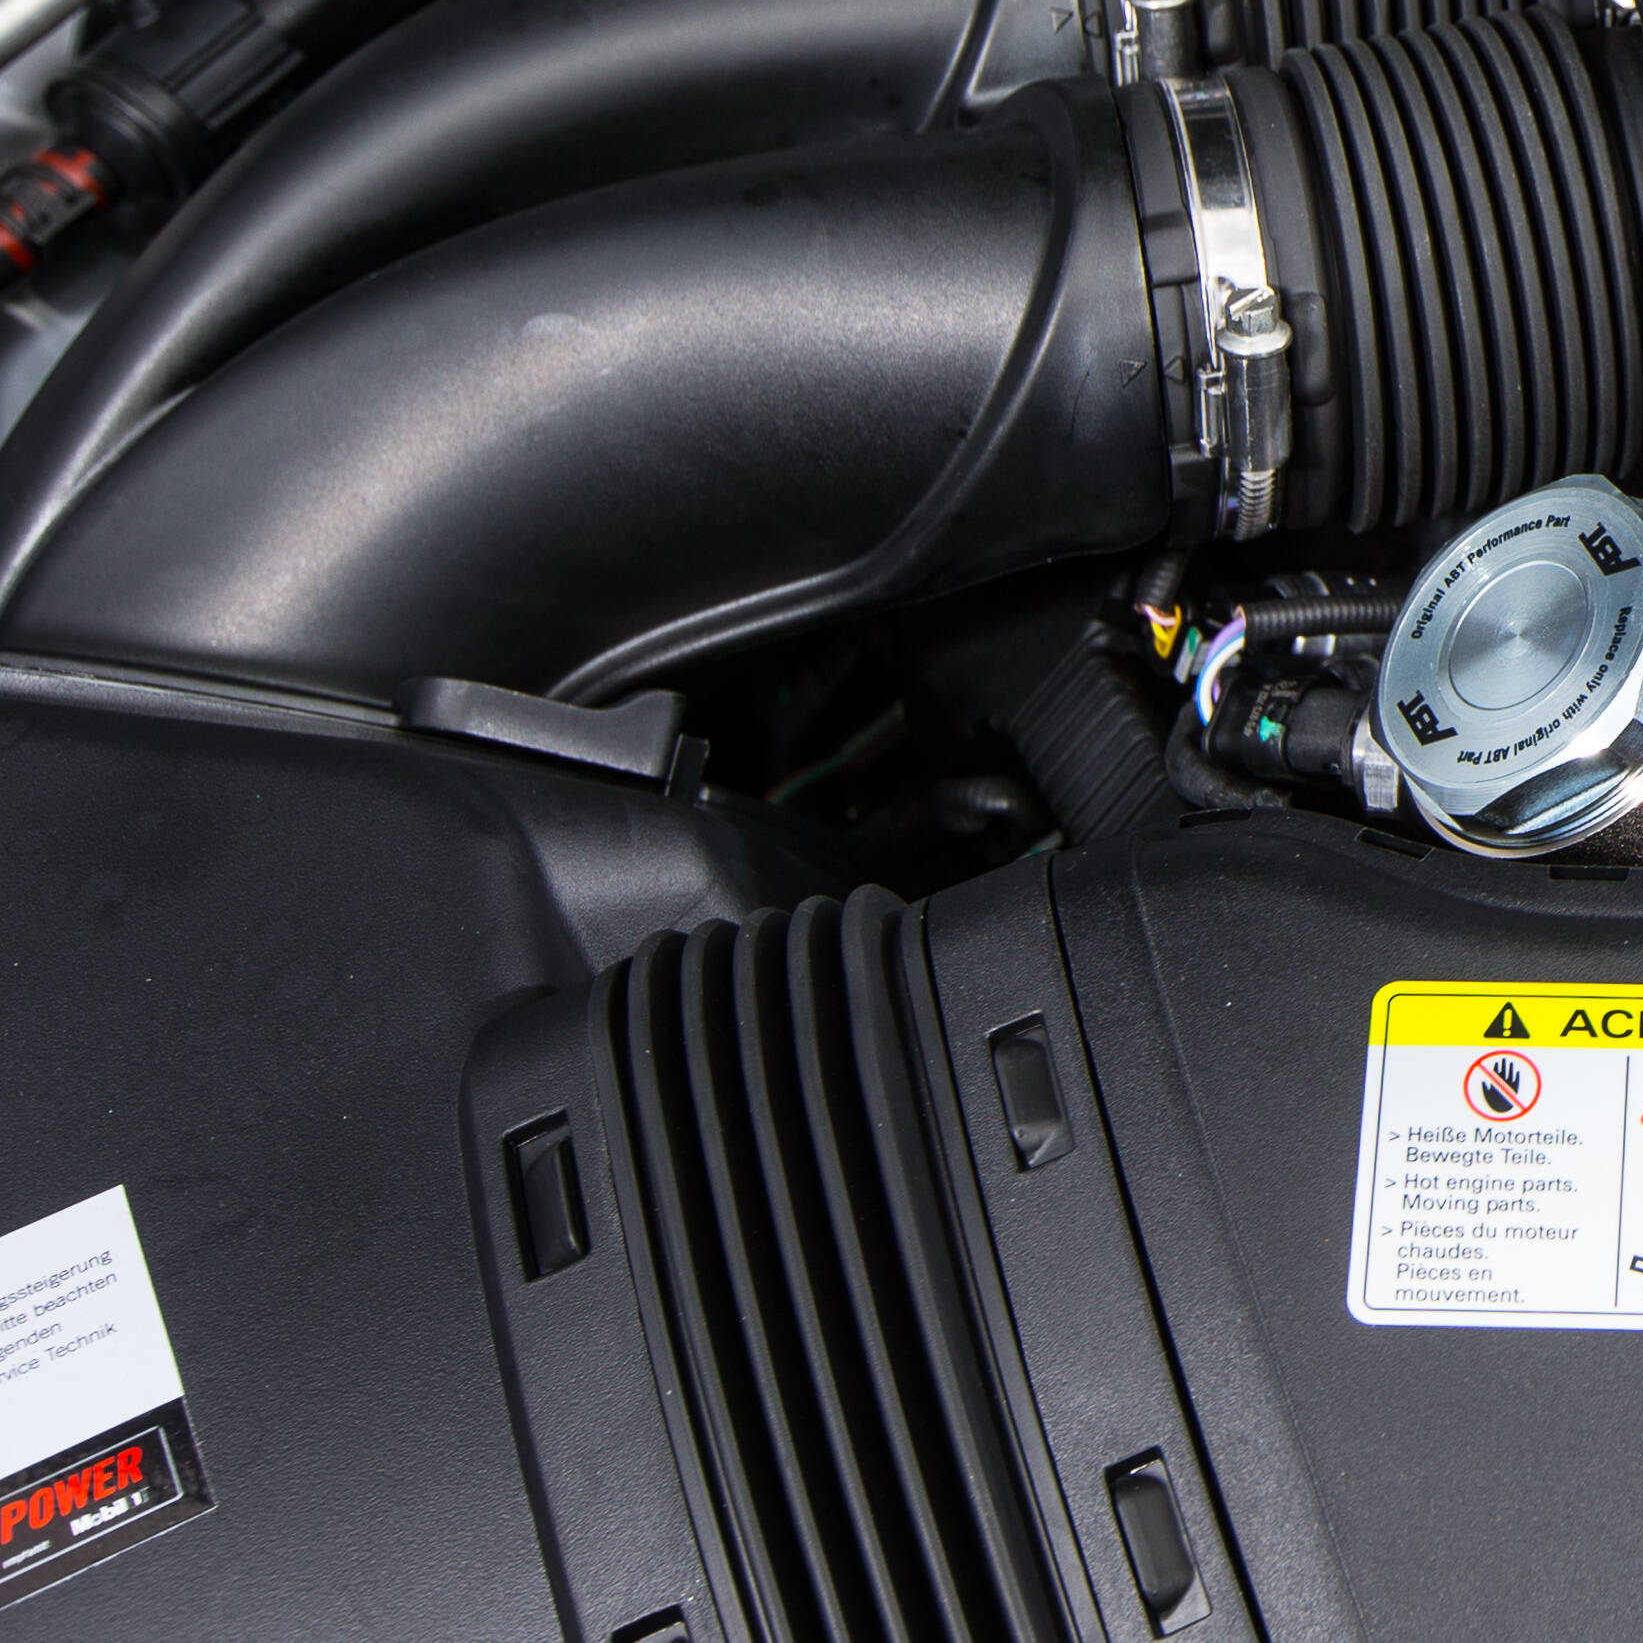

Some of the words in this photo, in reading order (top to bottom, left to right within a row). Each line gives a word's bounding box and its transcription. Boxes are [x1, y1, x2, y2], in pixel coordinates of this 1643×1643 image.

[1578, 522, 1642, 576] ABT
[1411, 588, 1446, 640] Original
[1444, 561, 1466, 588] ABT
[1466, 518, 1543, 565] Performance
[1545, 515, 1571, 528] Part
[1605, 606, 1633, 661] Replace
[1586, 664, 1609, 693] only
[1397, 689, 1458, 747] ABT
[1562, 694, 1589, 720] with
[1514, 718, 1561, 756] original
[1457, 750, 1483, 765] Part
[1484, 746, 1510, 764] ABT
[1407, 1125, 1467, 1144] Heiße
[1473, 1126, 1583, 1146] Motorteile.
[1405, 1146, 1494, 1168] Bewegte
[1500, 1147, 1552, 1166] Teile.
[1403, 1173, 1440, 1192] Hot
[1445, 1174, 1516, 1195] engine
[1521, 1177, 1578, 1196] parts.
[1402, 1194, 1480, 1216] Moving
[1486, 1196, 1540, 1216] parts.
[1471, 1222, 1497, 1239] du
[1504, 1225, 1579, 1241] moteur
[1397, 1241, 1488, 1261] chaudes.
[1468, 1268, 1493, 1281] en
[33, 1272, 118, 1317] beachten
[1395, 1288, 1525, 1304] mouvement.
[44, 1322, 118, 1361] Technik
[1, 1445, 143, 1545] POWER
